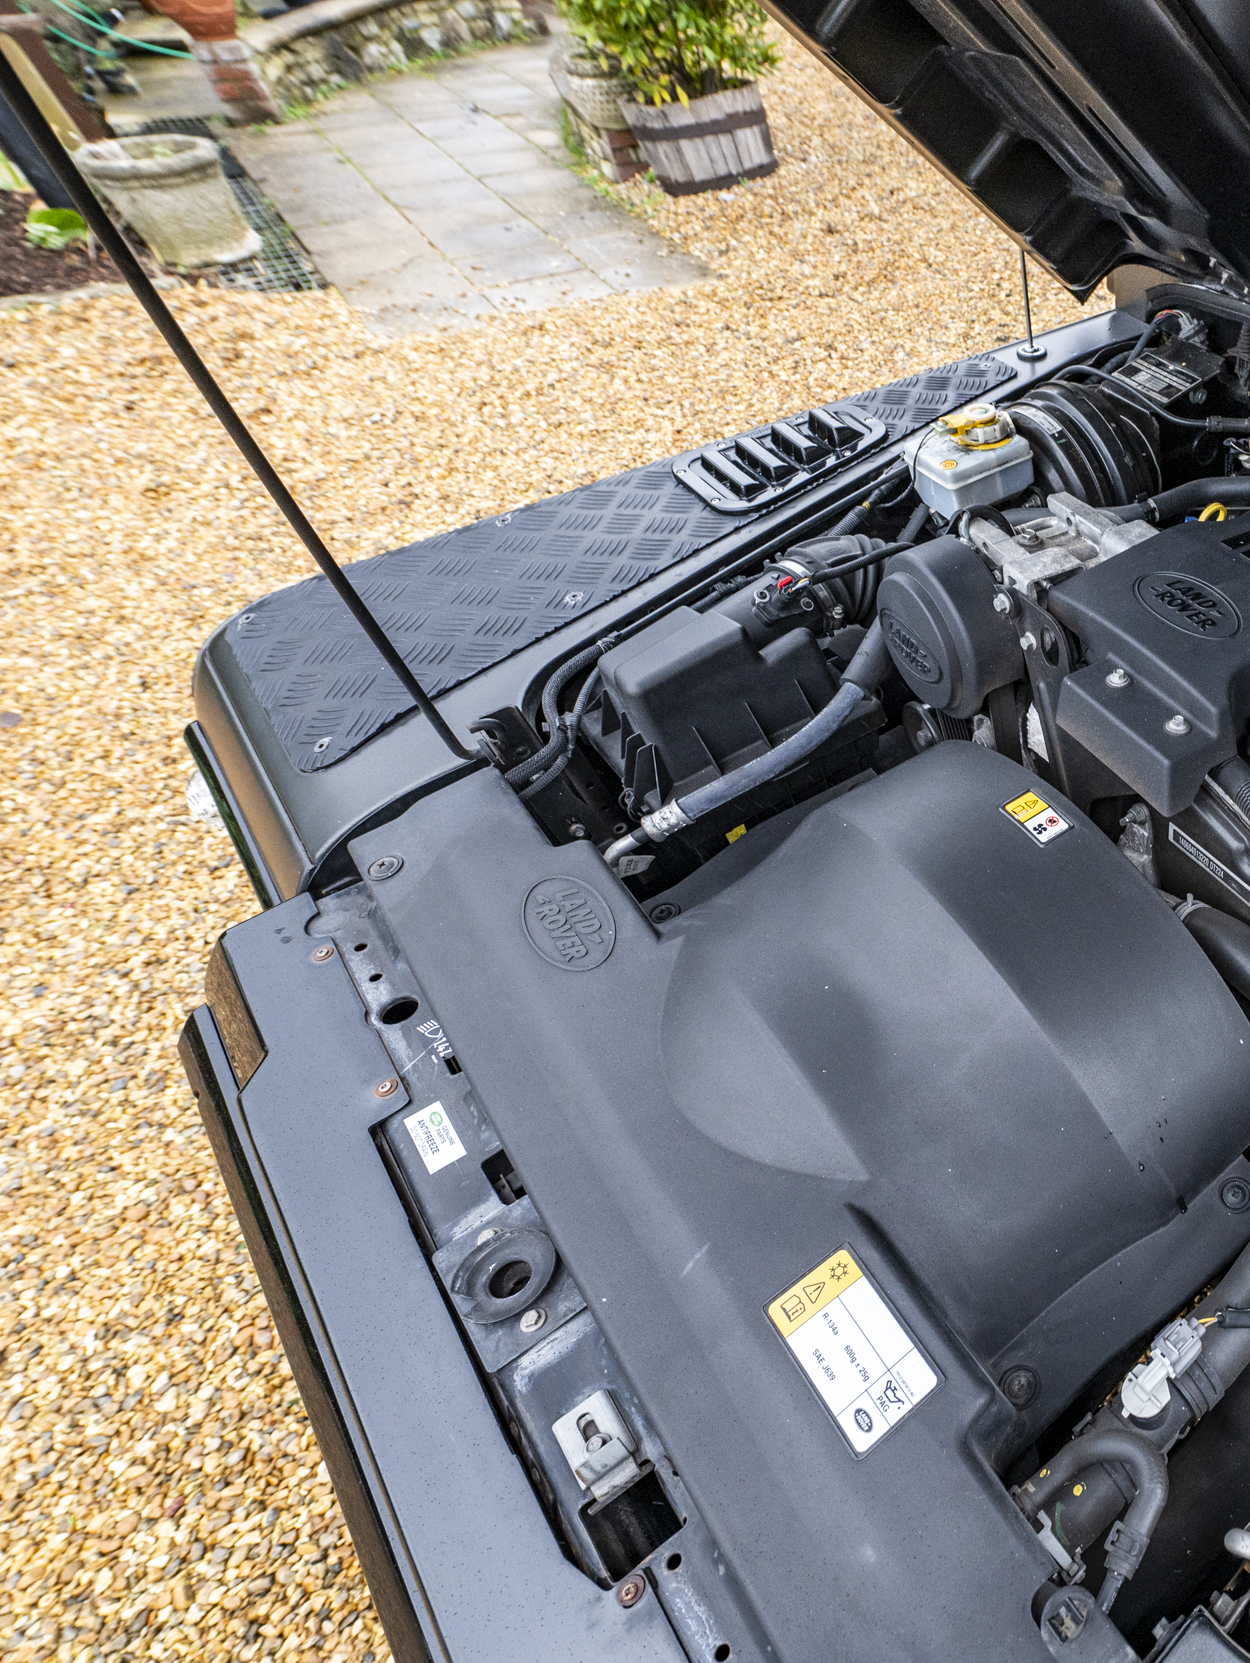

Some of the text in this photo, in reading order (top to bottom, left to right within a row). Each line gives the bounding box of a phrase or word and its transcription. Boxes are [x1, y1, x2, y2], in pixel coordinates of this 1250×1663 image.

[1153, 590, 1218, 632] ROVER
[1164, 580, 1218, 609] LAND
[888, 620, 919, 654] LAND
[892, 635, 932, 675] ROVER
[555, 888, 603, 935] LAND
[534, 904, 589, 964] ROVER
[416, 1119, 440, 1155] ANTIFREEZE
[435, 1128, 447, 1145] PARTS
[441, 1125, 455, 1146] GENUINE
[821, 1311, 839, 1336] R-134a
[812, 1348, 837, 1382] SAE J639
[843, 1344, 857, 1364] 600g
[858, 1366, 870, 1383] 25g
[876, 1395, 890, 1413] PAG
